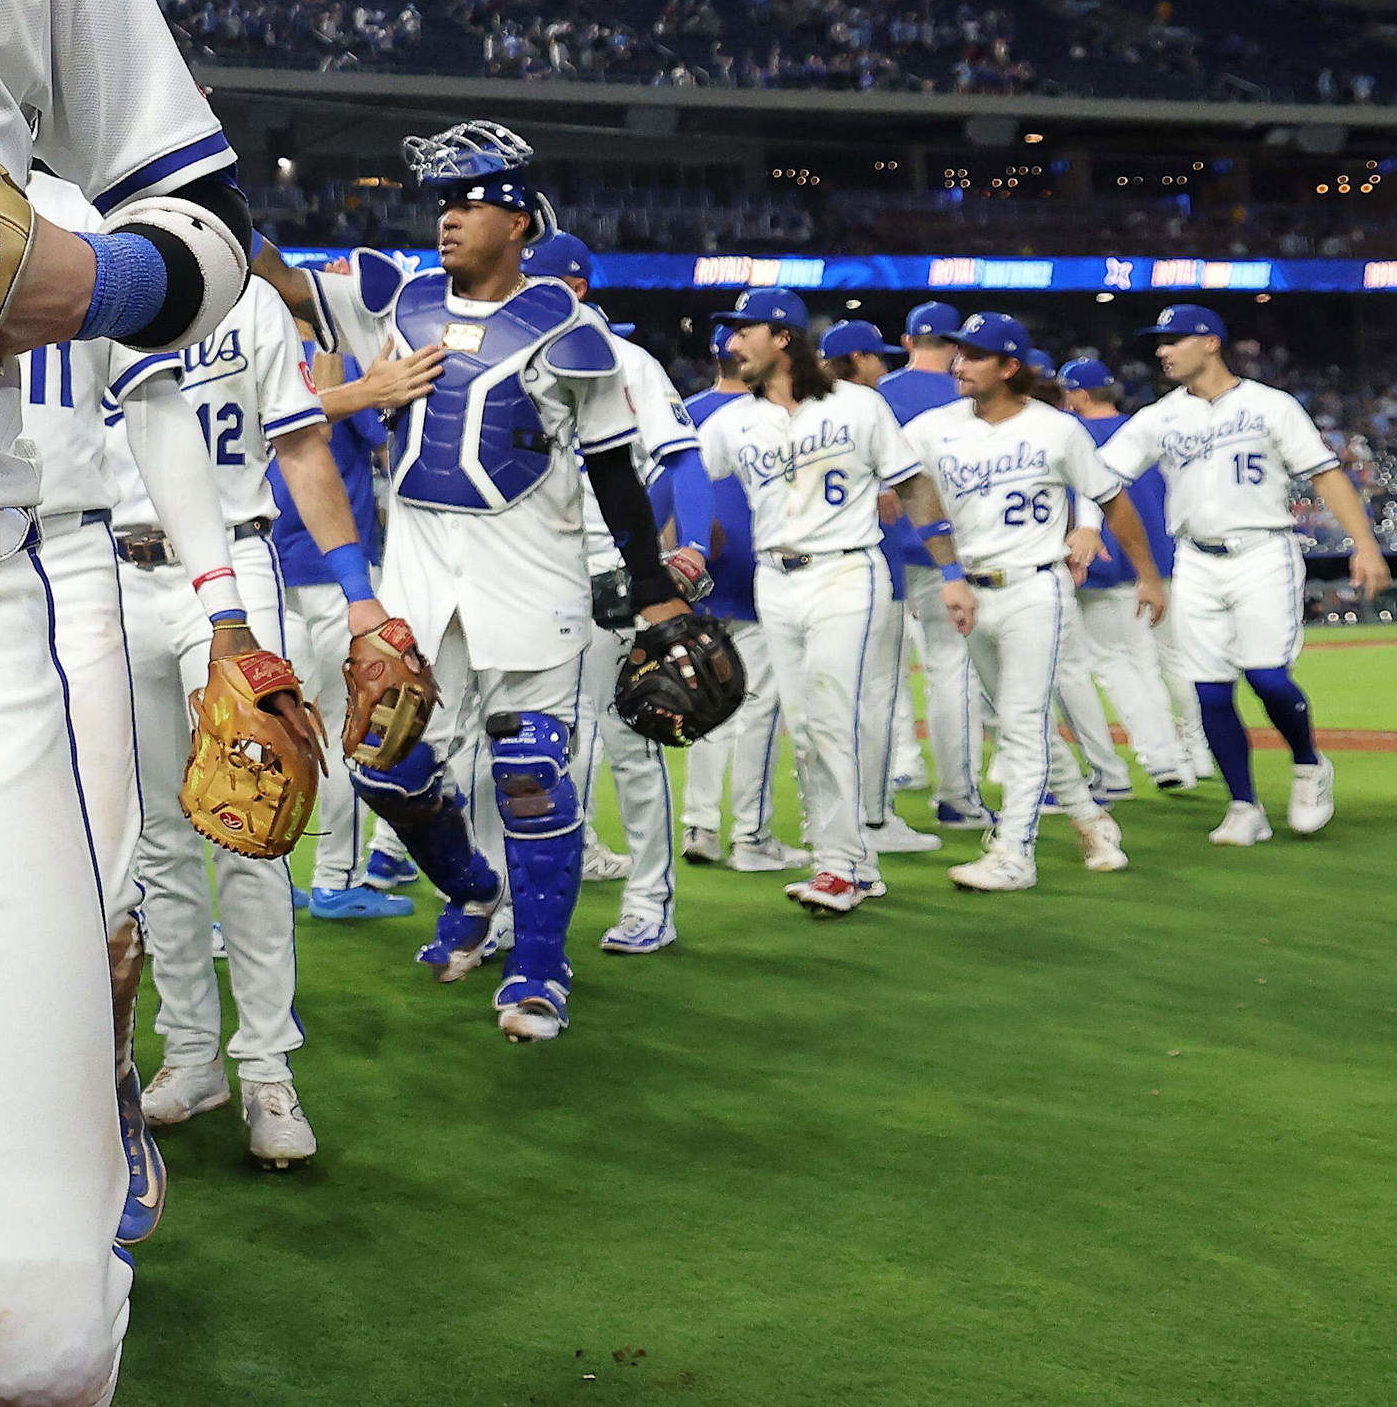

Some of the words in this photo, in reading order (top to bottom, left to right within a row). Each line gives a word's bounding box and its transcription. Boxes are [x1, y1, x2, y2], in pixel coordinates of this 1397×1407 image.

[196, 402, 246, 465] 12
[738, 418, 850, 485] Royals
[1160, 409, 1265, 461] Royals
[824, 469, 847, 505] 6
[938, 441, 1047, 497] Royals
[1233, 453, 1266, 485] 15
[1004, 489, 1051, 525] 26
